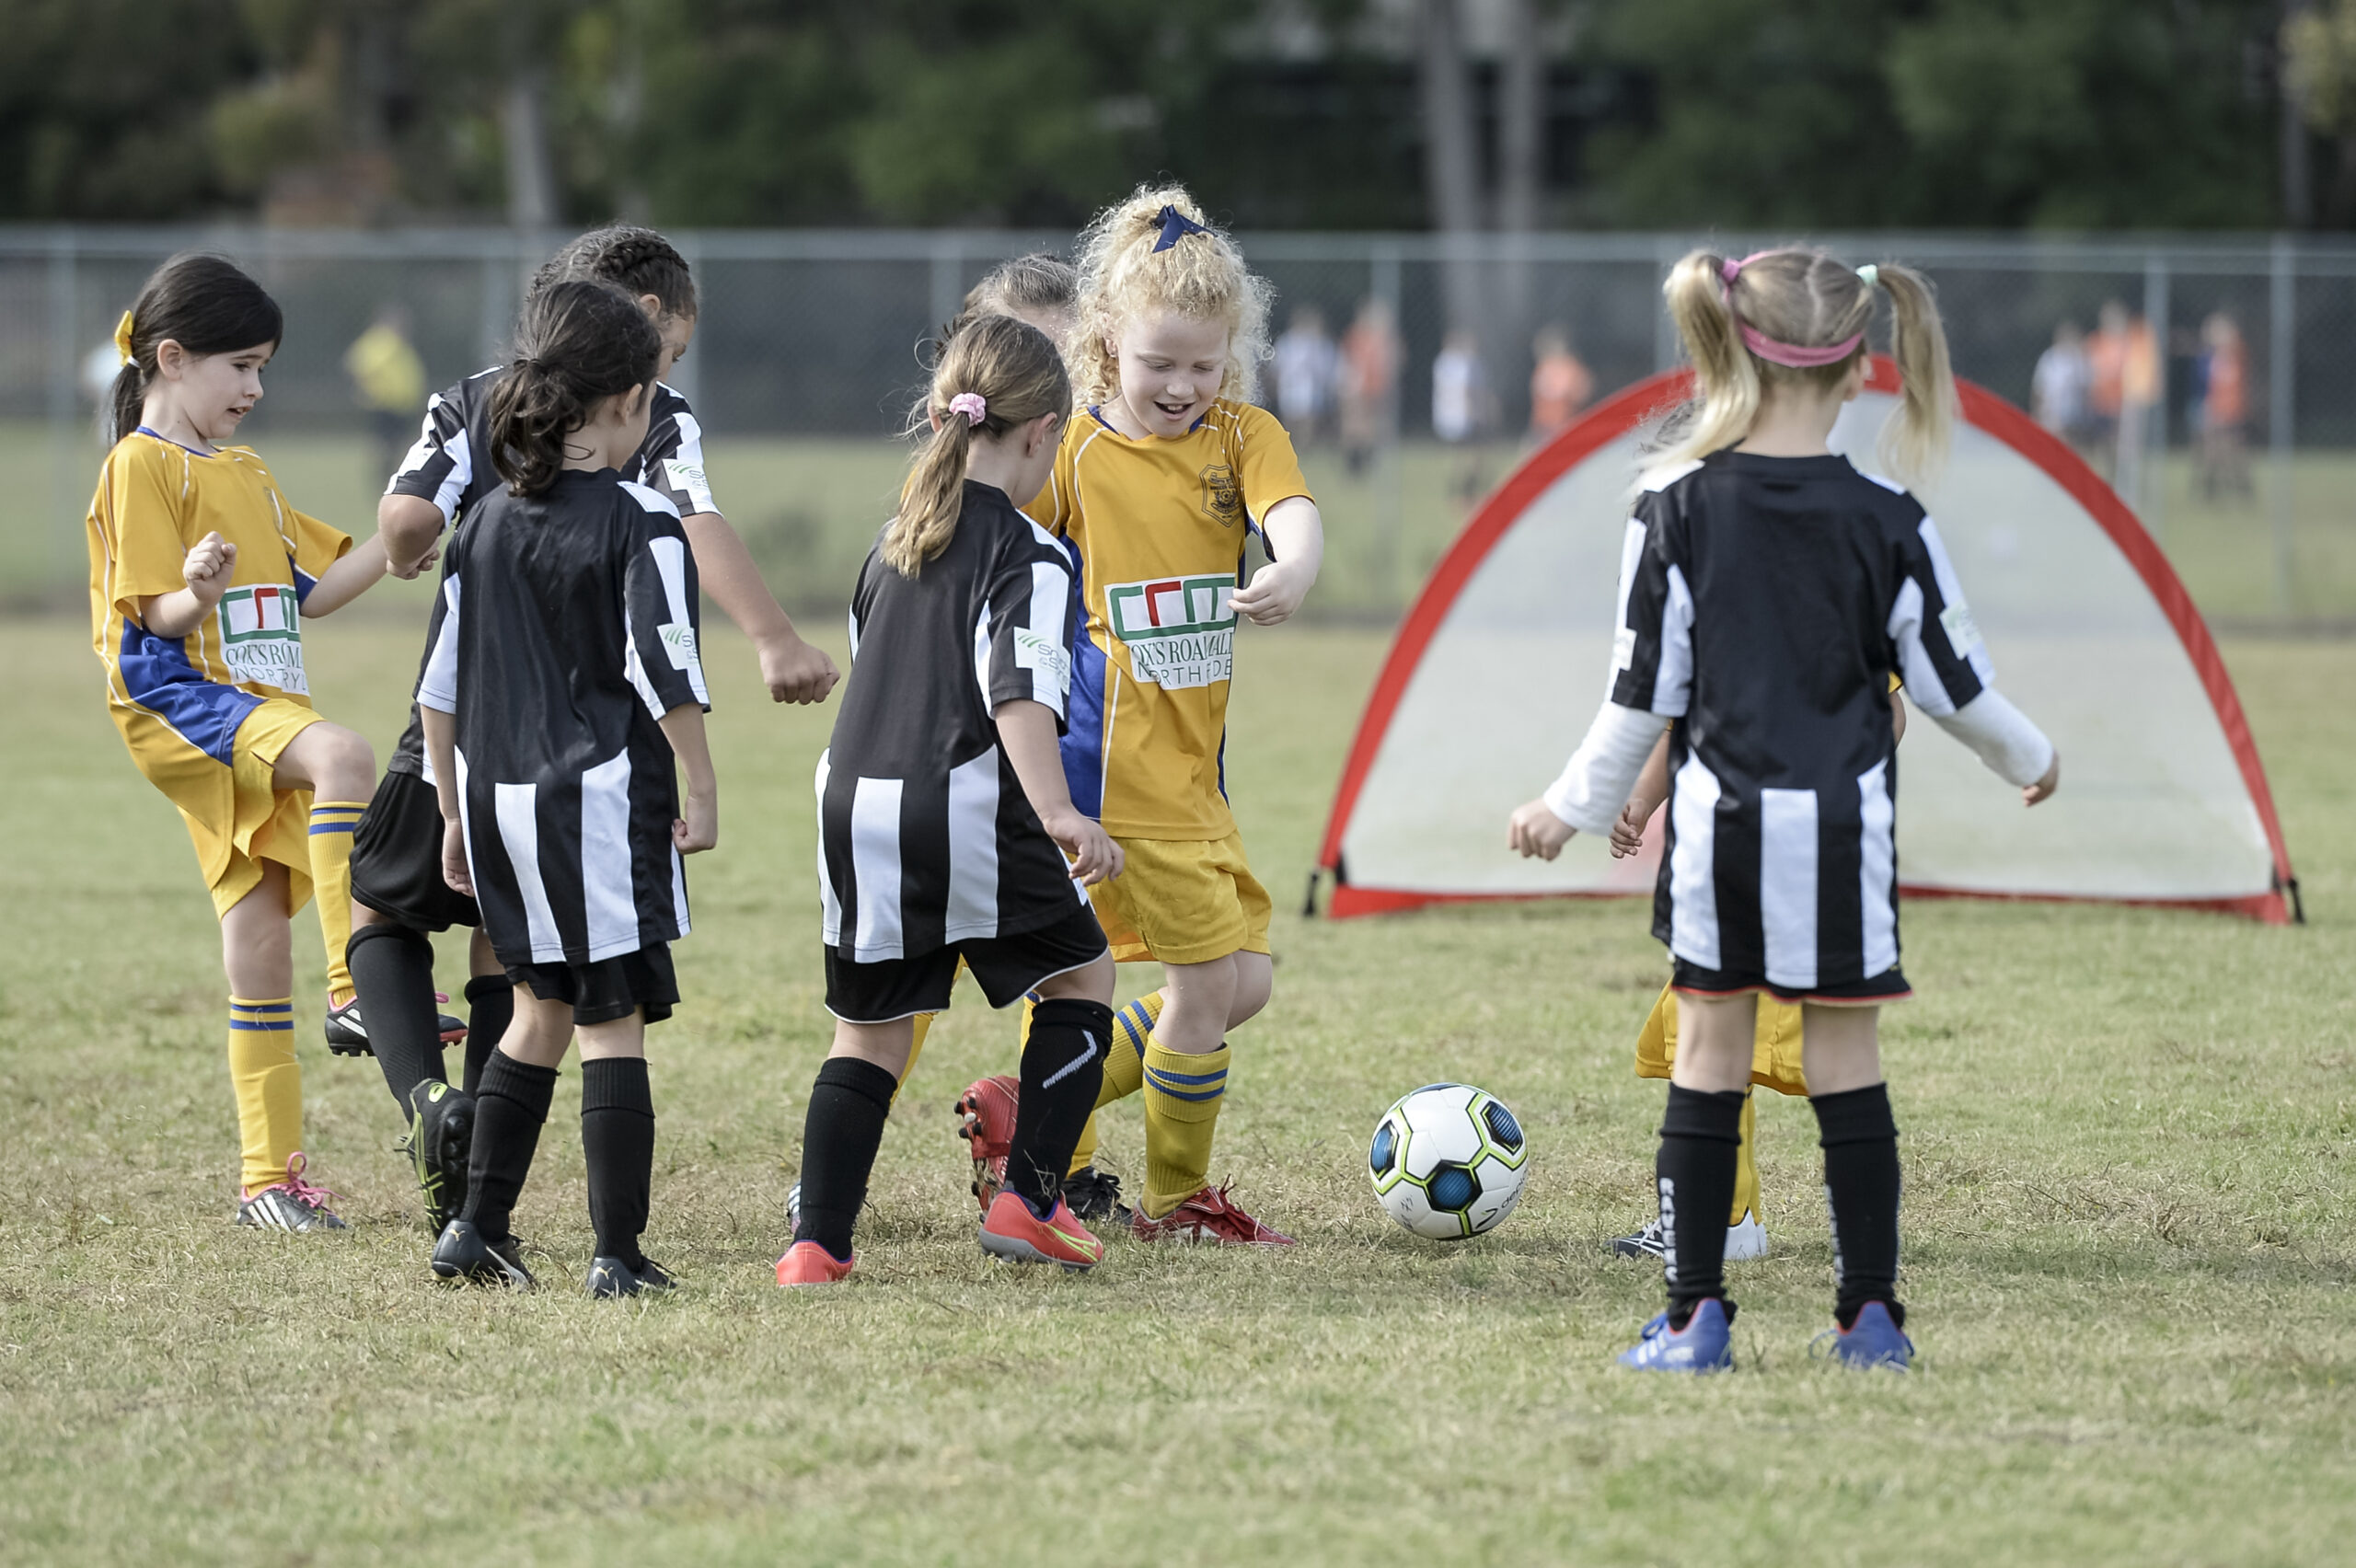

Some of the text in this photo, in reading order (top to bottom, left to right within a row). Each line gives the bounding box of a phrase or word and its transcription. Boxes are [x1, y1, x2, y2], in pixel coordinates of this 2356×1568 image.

[1131, 640, 1165, 666] OX'S
[1169, 636, 1207, 663] ROA
[235, 665, 284, 684] NORT
